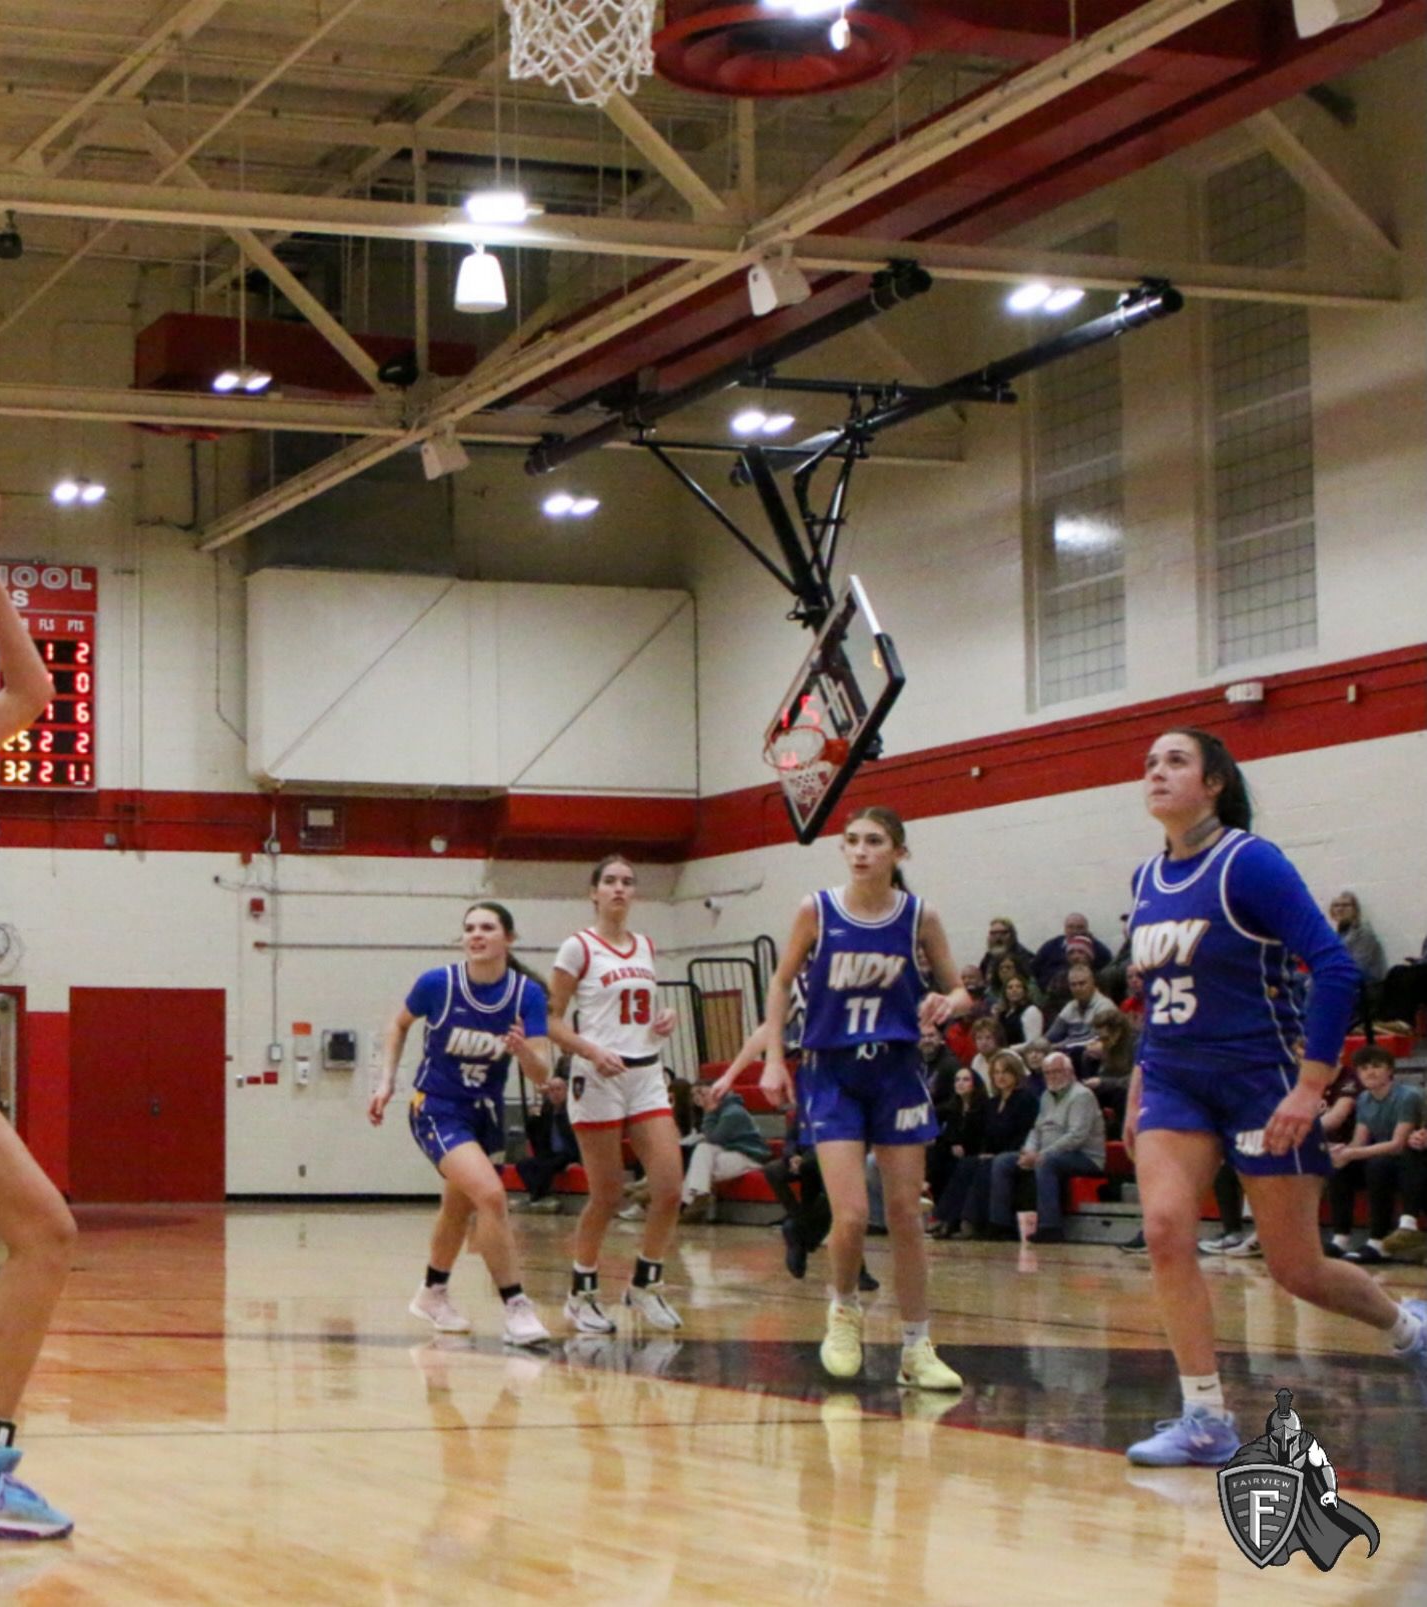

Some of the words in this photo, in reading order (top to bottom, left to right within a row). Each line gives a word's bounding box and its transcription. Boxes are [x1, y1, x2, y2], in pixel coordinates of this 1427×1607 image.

[46, 643, 54, 661] 1
[75, 642, 90, 664] 2
[75, 671, 90, 694] 0
[75, 702, 90, 724] 6
[39, 730, 54, 753] 2
[75, 732, 90, 754] 2
[3, 760, 32, 782] 32
[39, 760, 54, 783] 2
[828, 951, 907, 992] INDY
[619, 988, 651, 1025] 13
[1150, 975, 1198, 1025] 25
[846, 996, 882, 1035] 11
